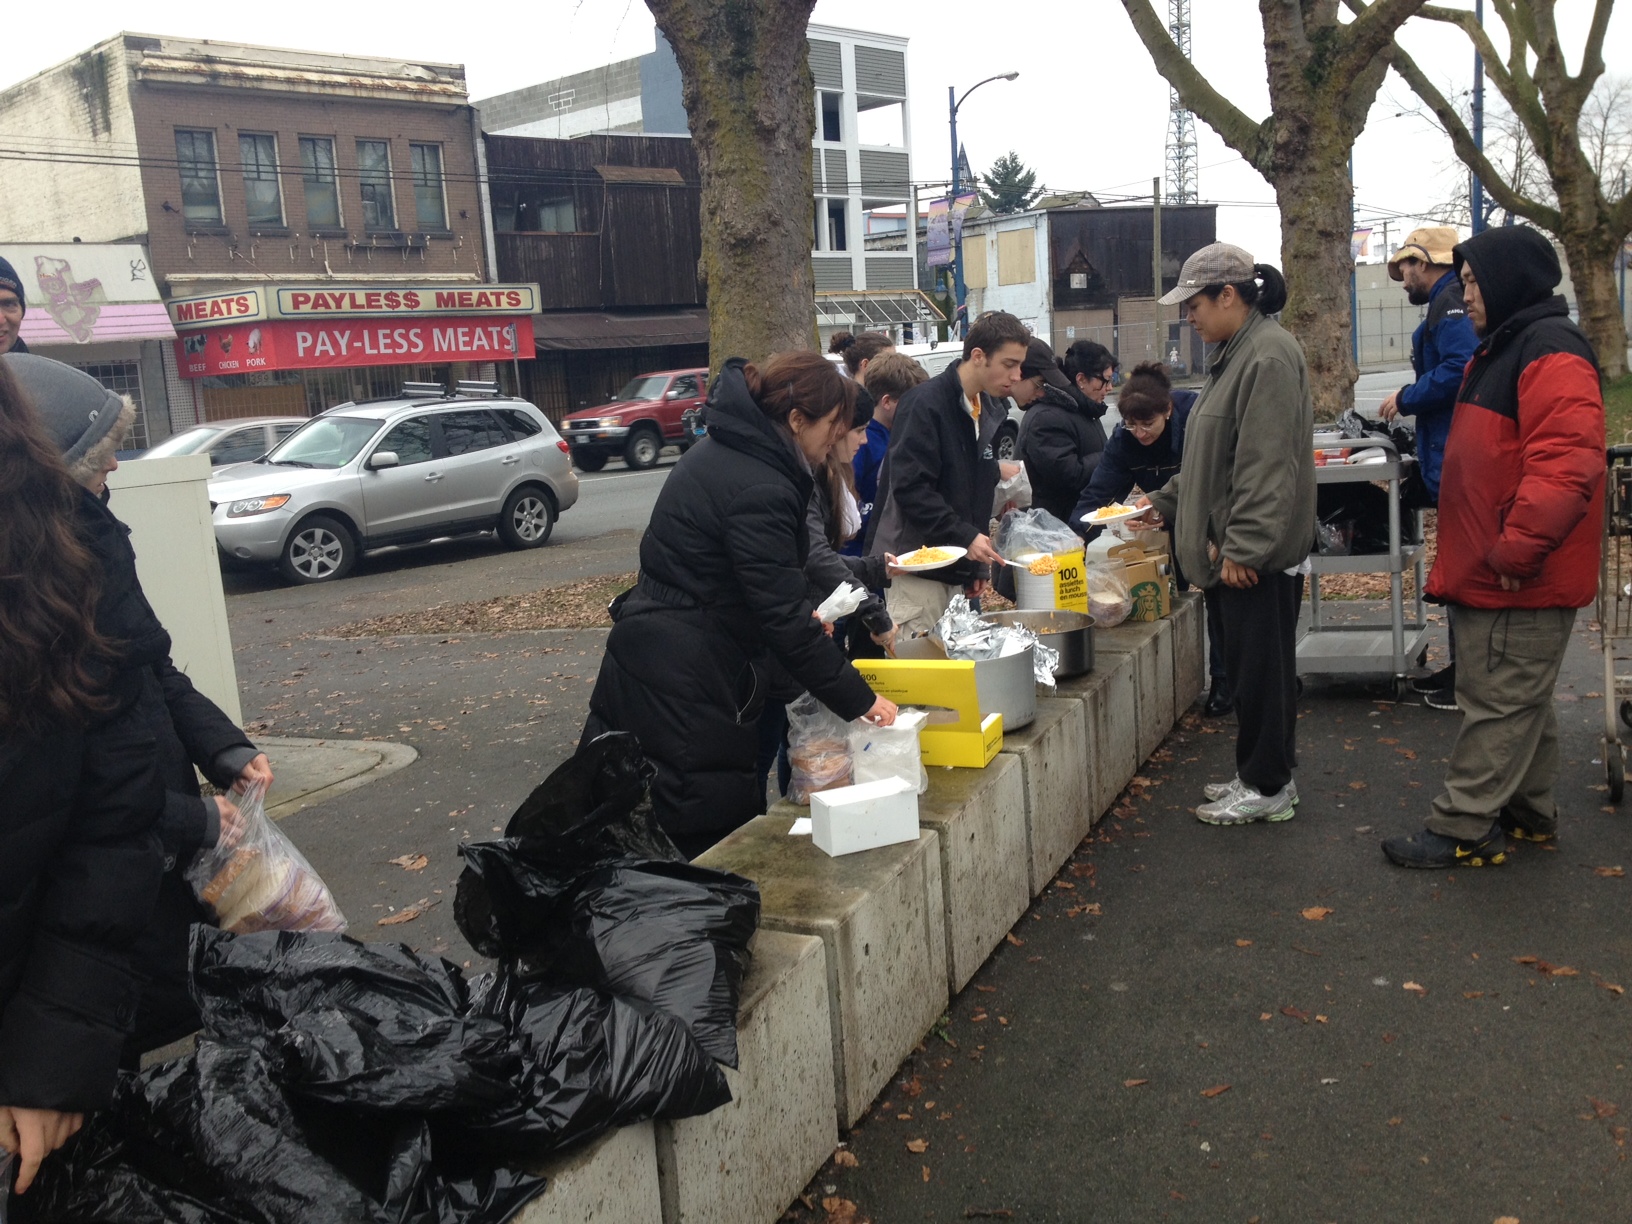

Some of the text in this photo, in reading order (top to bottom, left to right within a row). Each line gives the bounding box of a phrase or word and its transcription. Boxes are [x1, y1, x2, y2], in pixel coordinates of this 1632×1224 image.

[290, 290, 522, 311] PAYLE$$ MEATS
[176, 295, 250, 322] MEATS
[296, 325, 516, 357] PAY-LESS MEATS
[189, 363, 207, 372] BEEF
[218, 360, 240, 370] CHICKEN
[246, 357, 267, 367] PORK
[1058, 567, 1078, 580] 100
